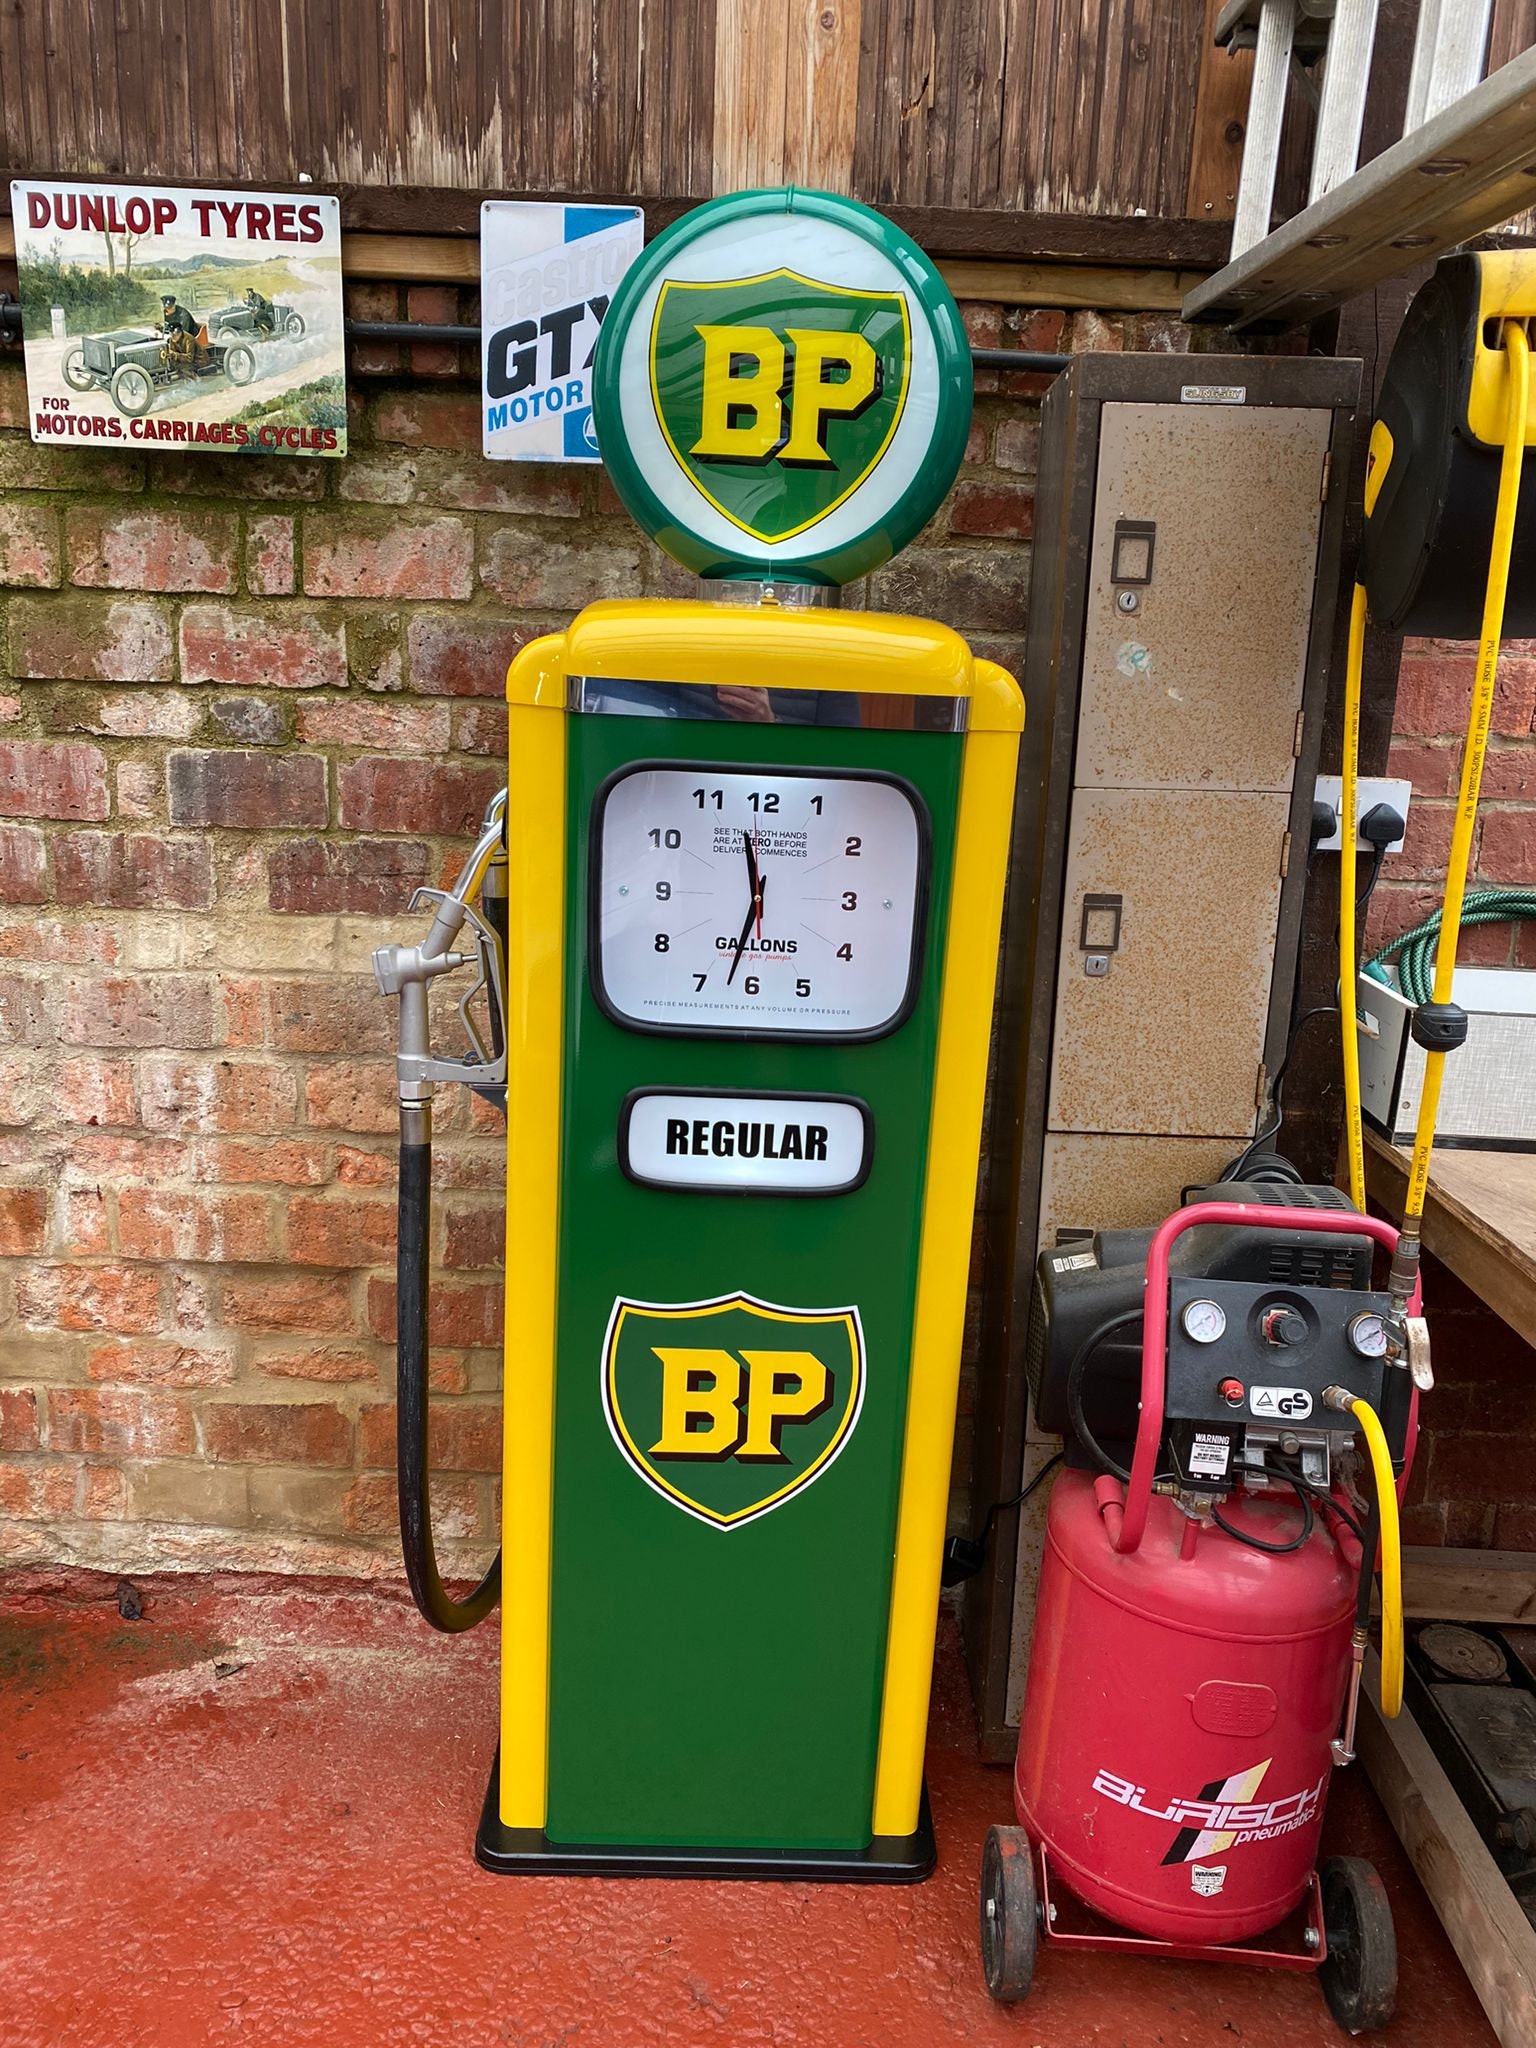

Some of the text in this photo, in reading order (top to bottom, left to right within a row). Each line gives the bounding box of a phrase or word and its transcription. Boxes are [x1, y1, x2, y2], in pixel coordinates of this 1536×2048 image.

[27, 192, 324, 243] DUNLOP TYRES
[42, 397, 69, 411] FOR
[488, 380, 583, 432] MOTOR
[688, 324, 885, 471] BP
[36, 413, 127, 440] MOTORS,
[259, 425, 337, 450] CYCLES
[1486, 640, 1495, 657] PVC
[1483, 660, 1493, 683] HOSE
[692, 789, 723, 809] 11
[747, 793, 779, 813] 12
[811, 795, 823, 815] 1
[648, 828, 681, 849] 10
[713, 836, 807, 848] ARE AT ERO BEFORE
[714, 827, 730, 835] SEE
[755, 830, 777, 838] BOTH
[779, 832, 807, 840] HANDS
[713, 845, 807, 858] DELIVER COMMENCES
[845, 837, 861, 857] 2
[655, 882, 671, 901] 9
[841, 892, 857, 911] 3
[654, 934, 670, 953] 8
[836, 943, 853, 962] 4
[692, 974, 707, 992] 7
[744, 976, 760, 995] 6
[796, 979, 811, 997] 5
[679, 1001, 739, 1010] MEASUREMENTS
[666, 1118, 829, 1161] REGULAR
[1419, 1146, 1428, 1161] PVC
[1416, 1163, 1426, 1184] HOSE
[647, 1346, 835, 1465] BP
[1278, 1392, 1308, 1415] GS
[1195, 1432, 1230, 1446] WARNING
[1233, 1804, 1317, 1847] pneumatics
